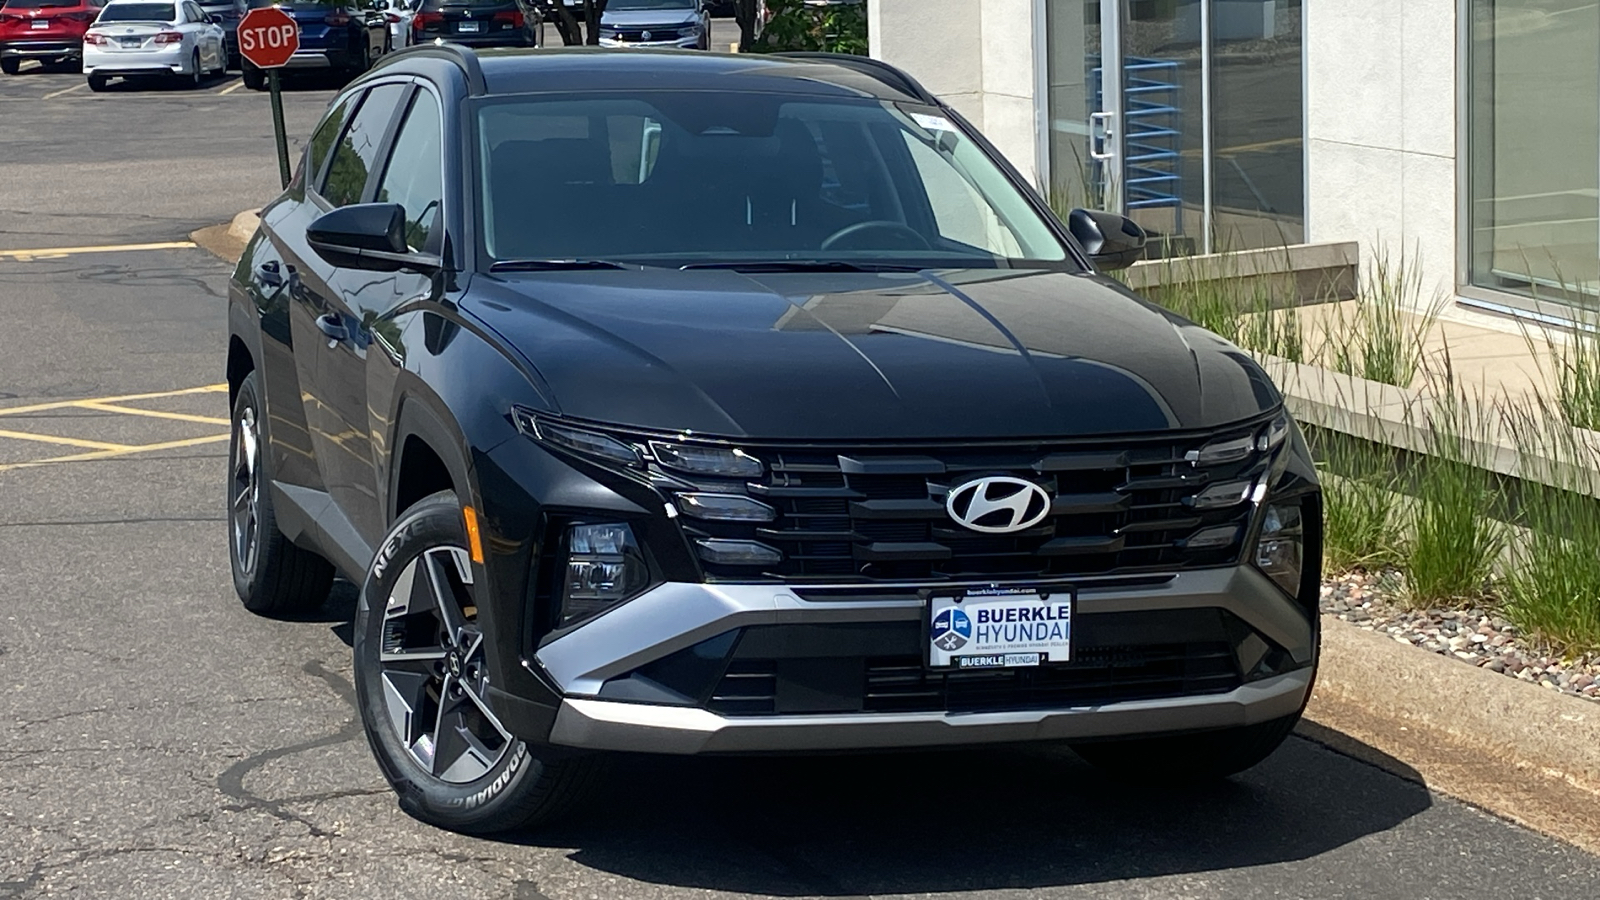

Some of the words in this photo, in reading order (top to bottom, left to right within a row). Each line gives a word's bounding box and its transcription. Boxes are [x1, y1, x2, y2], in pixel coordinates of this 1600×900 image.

[242, 25, 295, 50] STOP
[977, 606, 1069, 623] BUERKLE
[976, 621, 1069, 644] HYUNDAI
[961, 655, 1004, 666] BUERKLE
[1005, 654, 1038, 664] HYUNDAI
